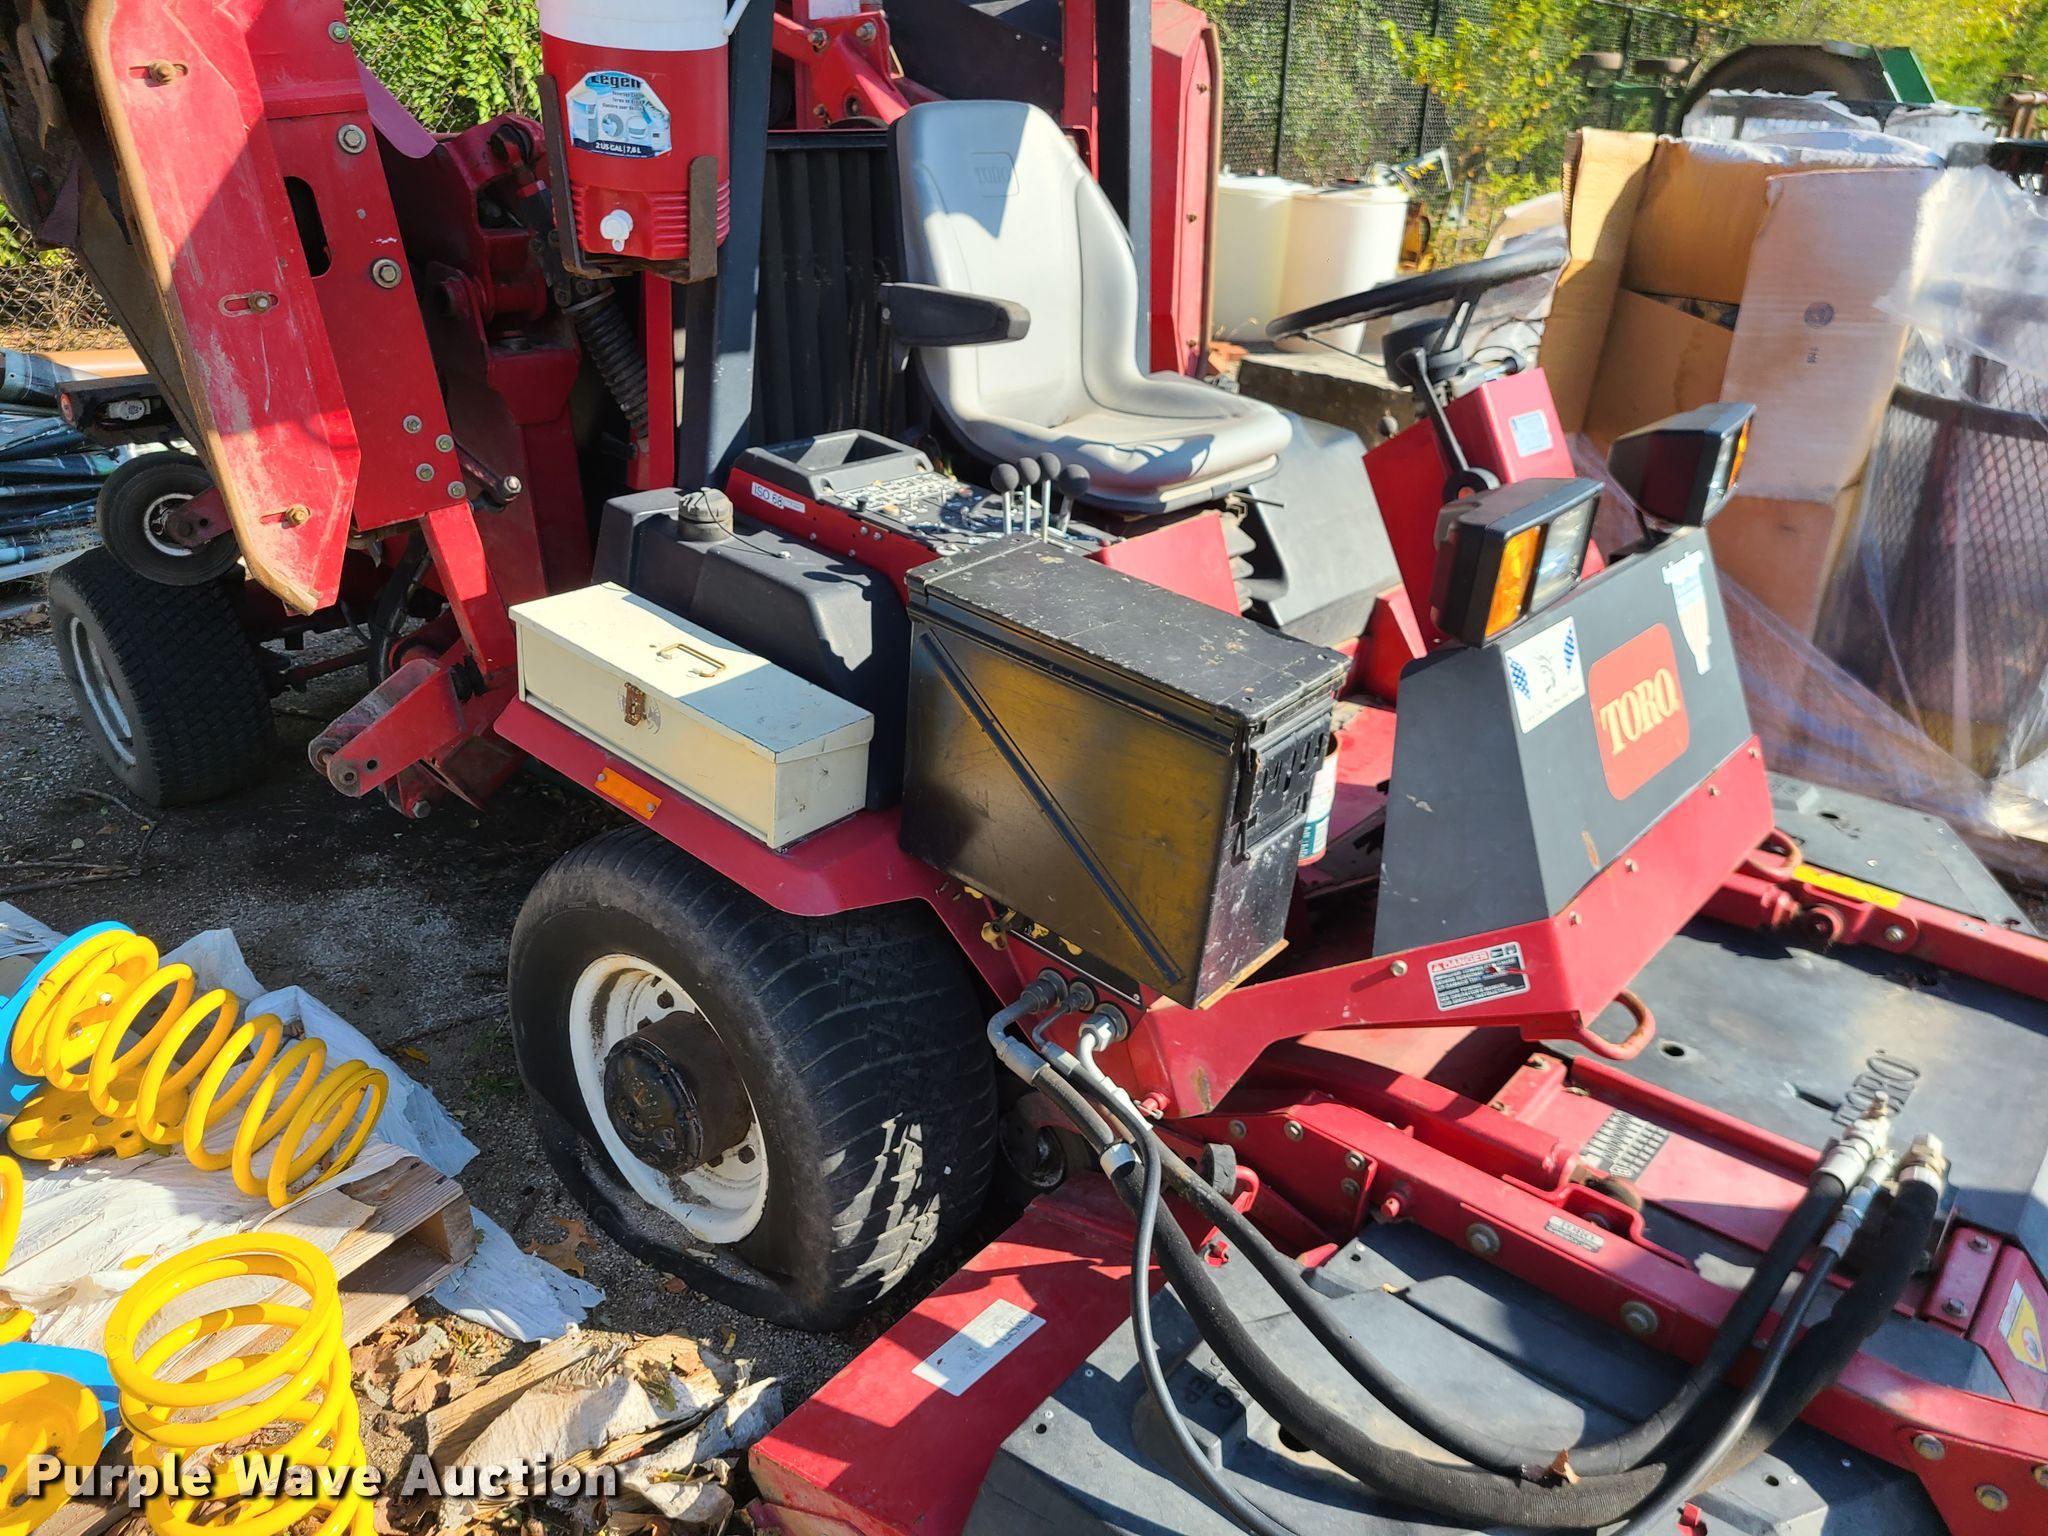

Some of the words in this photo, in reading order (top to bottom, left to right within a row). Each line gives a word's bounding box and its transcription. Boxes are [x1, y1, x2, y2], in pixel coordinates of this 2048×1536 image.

[754, 485, 770, 500] ISO
[772, 494, 783, 507] 68
[1444, 951, 1490, 968] DANGER
